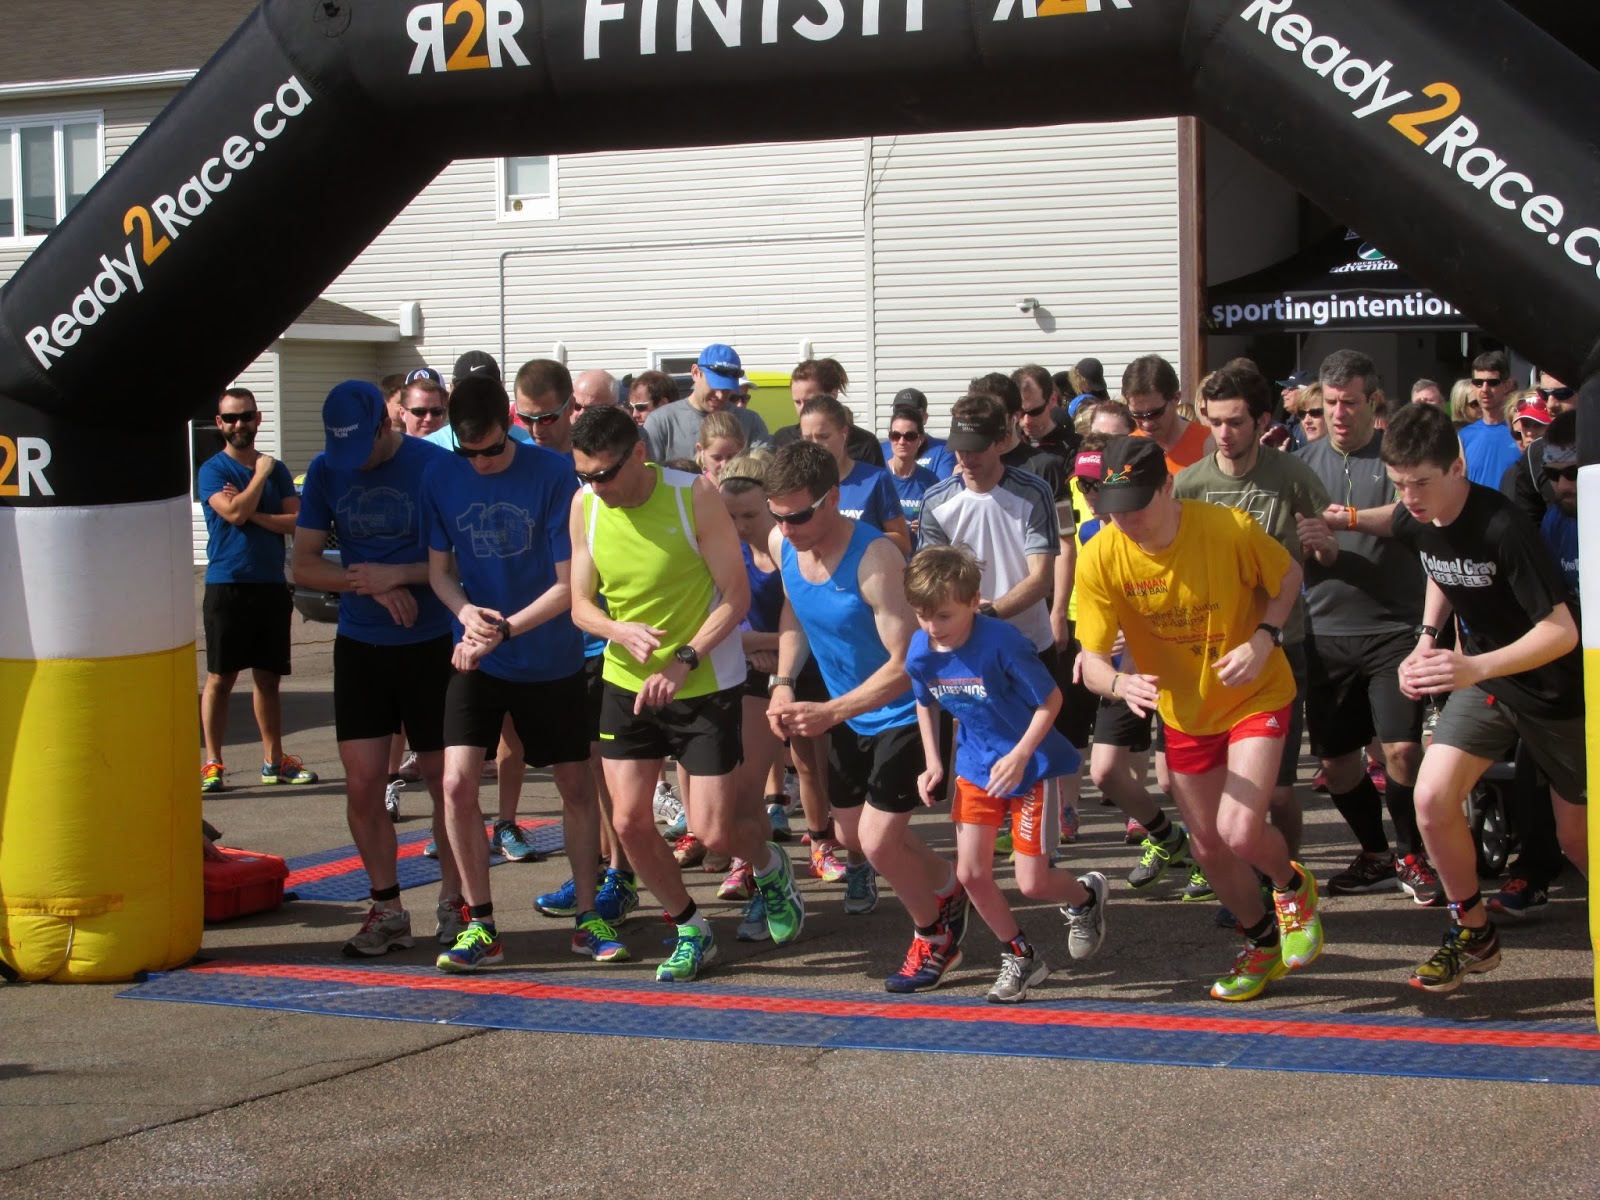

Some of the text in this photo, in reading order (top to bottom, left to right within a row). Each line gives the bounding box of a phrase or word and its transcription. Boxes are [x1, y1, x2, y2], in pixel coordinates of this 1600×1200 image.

[1240, 0, 1600, 281] Ready2Race.c
[24, 75, 313, 370] Ready2Race.ca
[1124, 578, 1167, 592] RUNMAN
[1433, 573, 1489, 586] COLOELS
